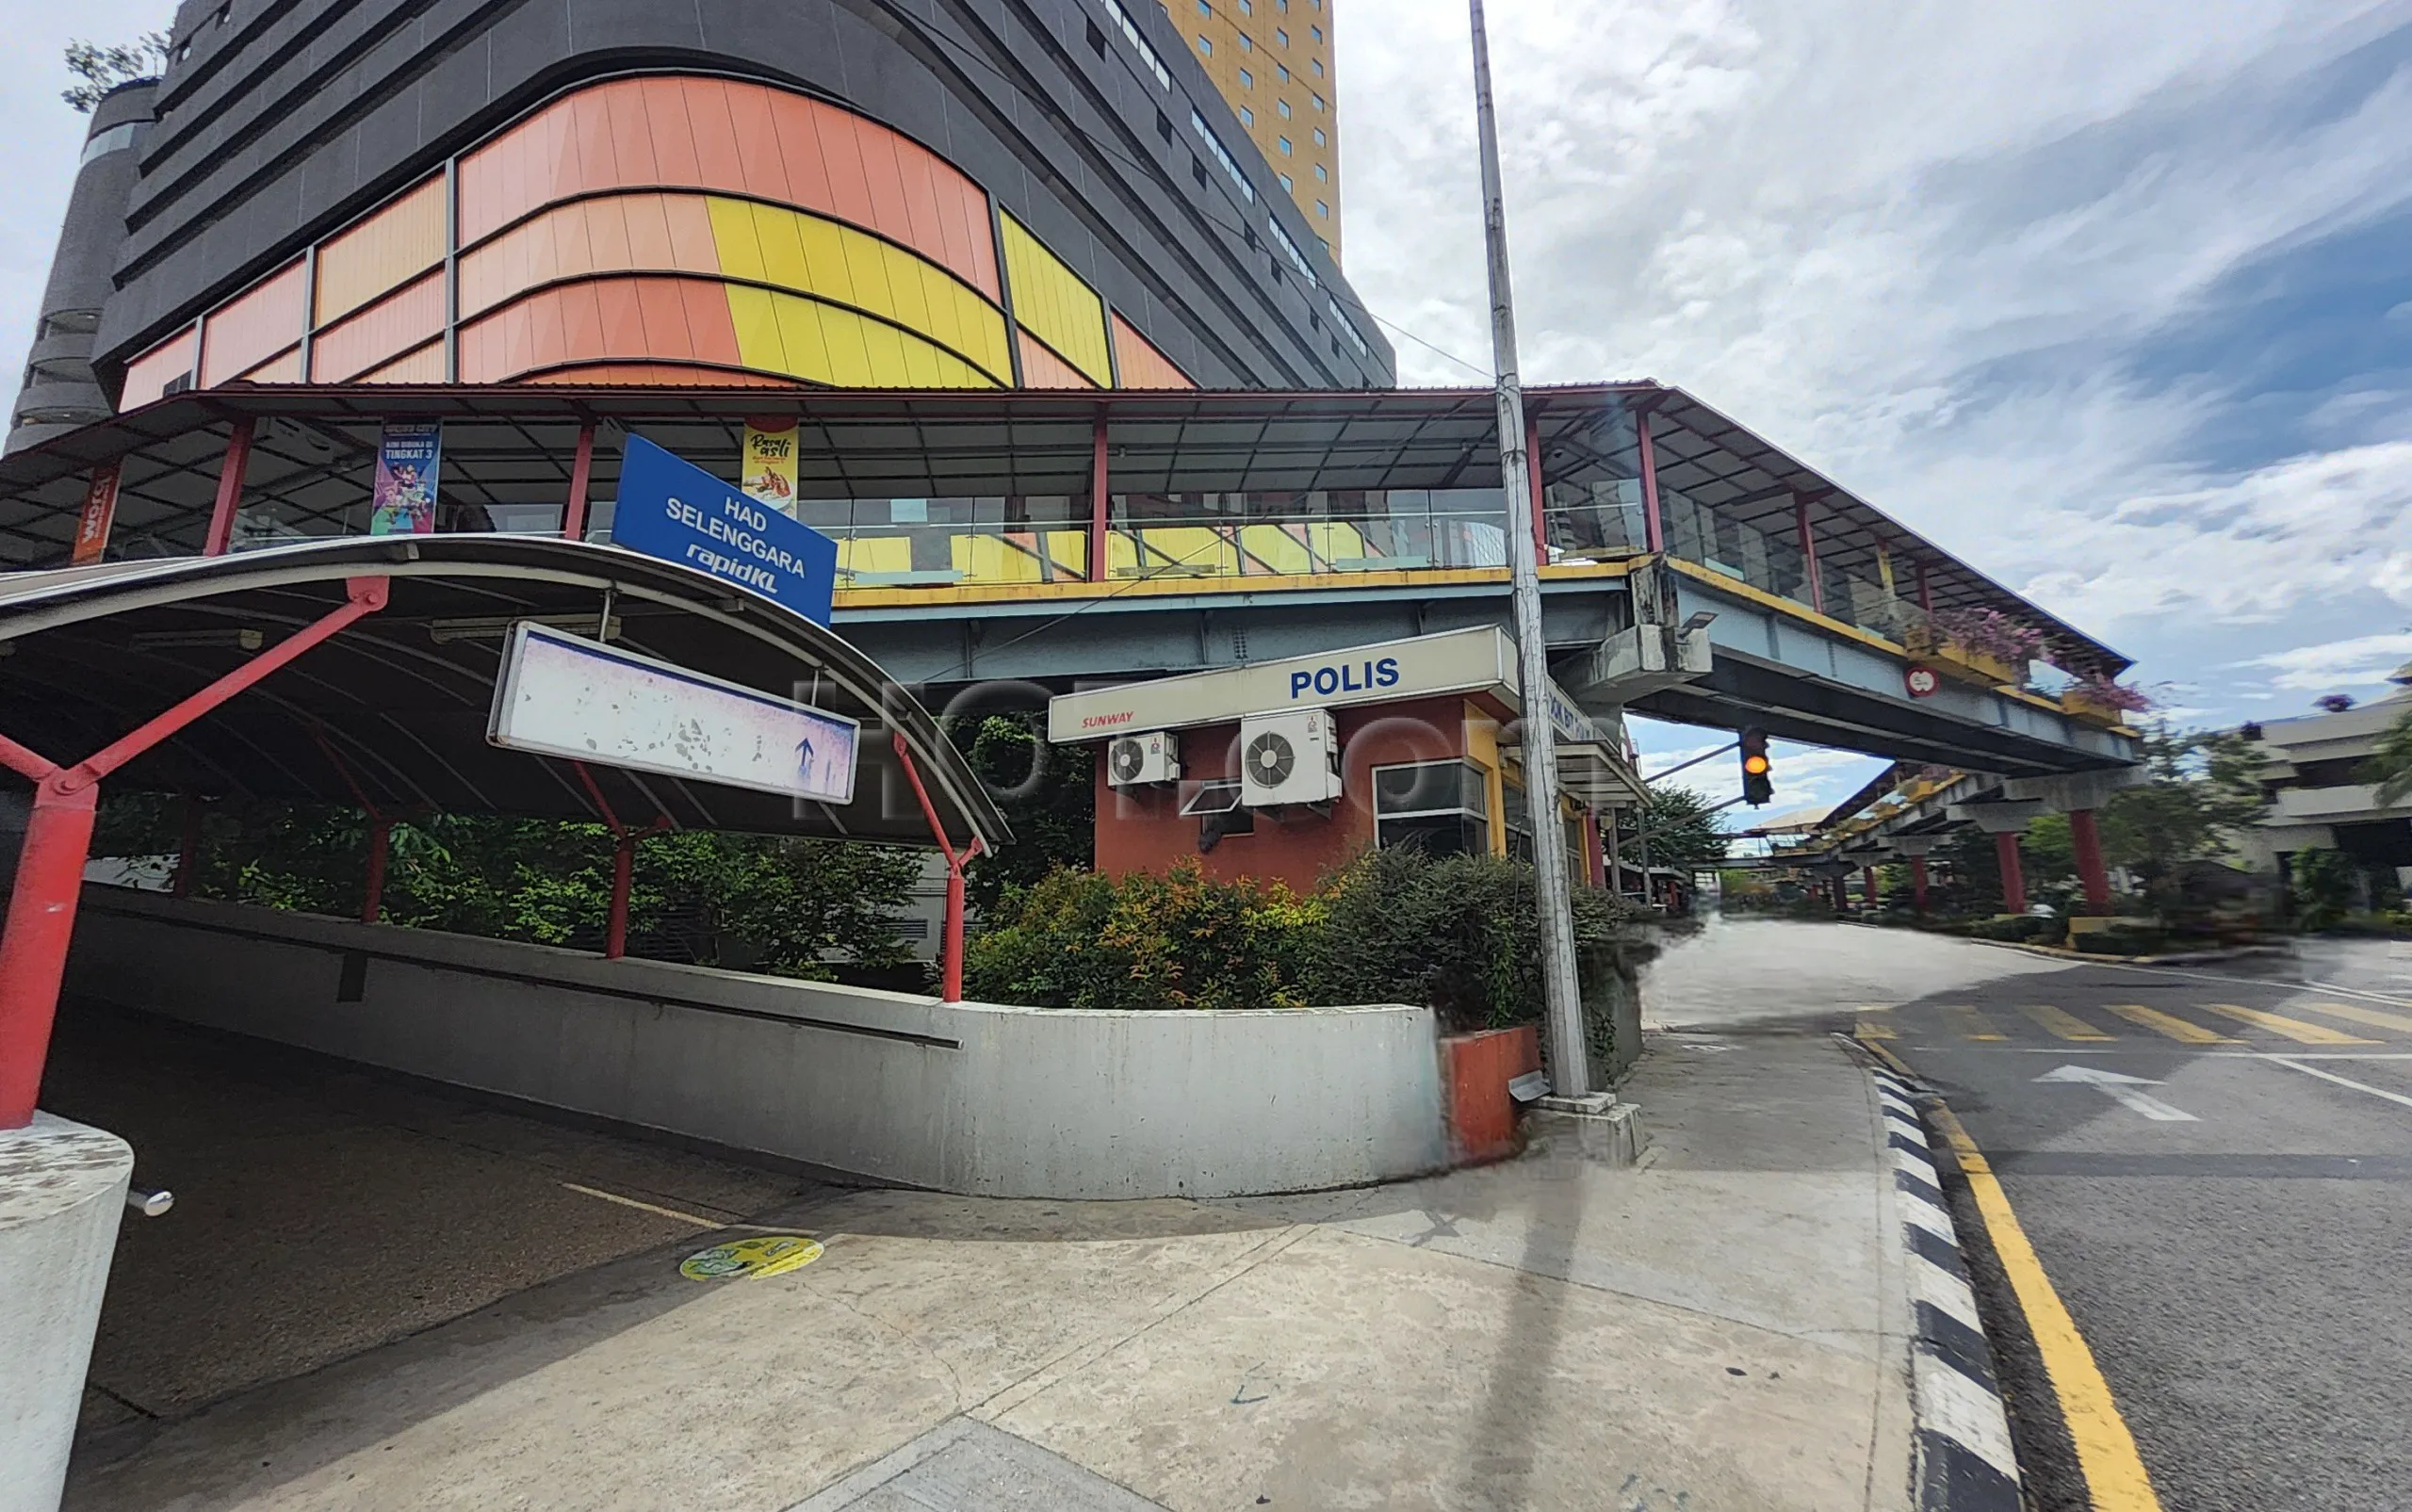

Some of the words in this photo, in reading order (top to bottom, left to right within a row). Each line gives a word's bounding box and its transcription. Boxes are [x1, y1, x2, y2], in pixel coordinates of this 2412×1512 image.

[385, 449, 424, 460] TINGKAT
[425, 449, 433, 460] 3
[750, 433, 781, 449] Rasa
[759, 438, 791, 457] asli
[725, 496, 767, 532] HAD
[665, 497, 806, 578] SELENGGARA
[686, 543, 778, 594] rapidKL
[1290, 658, 1400, 699] POLIS
[1081, 710, 1134, 729] SUNWAY
